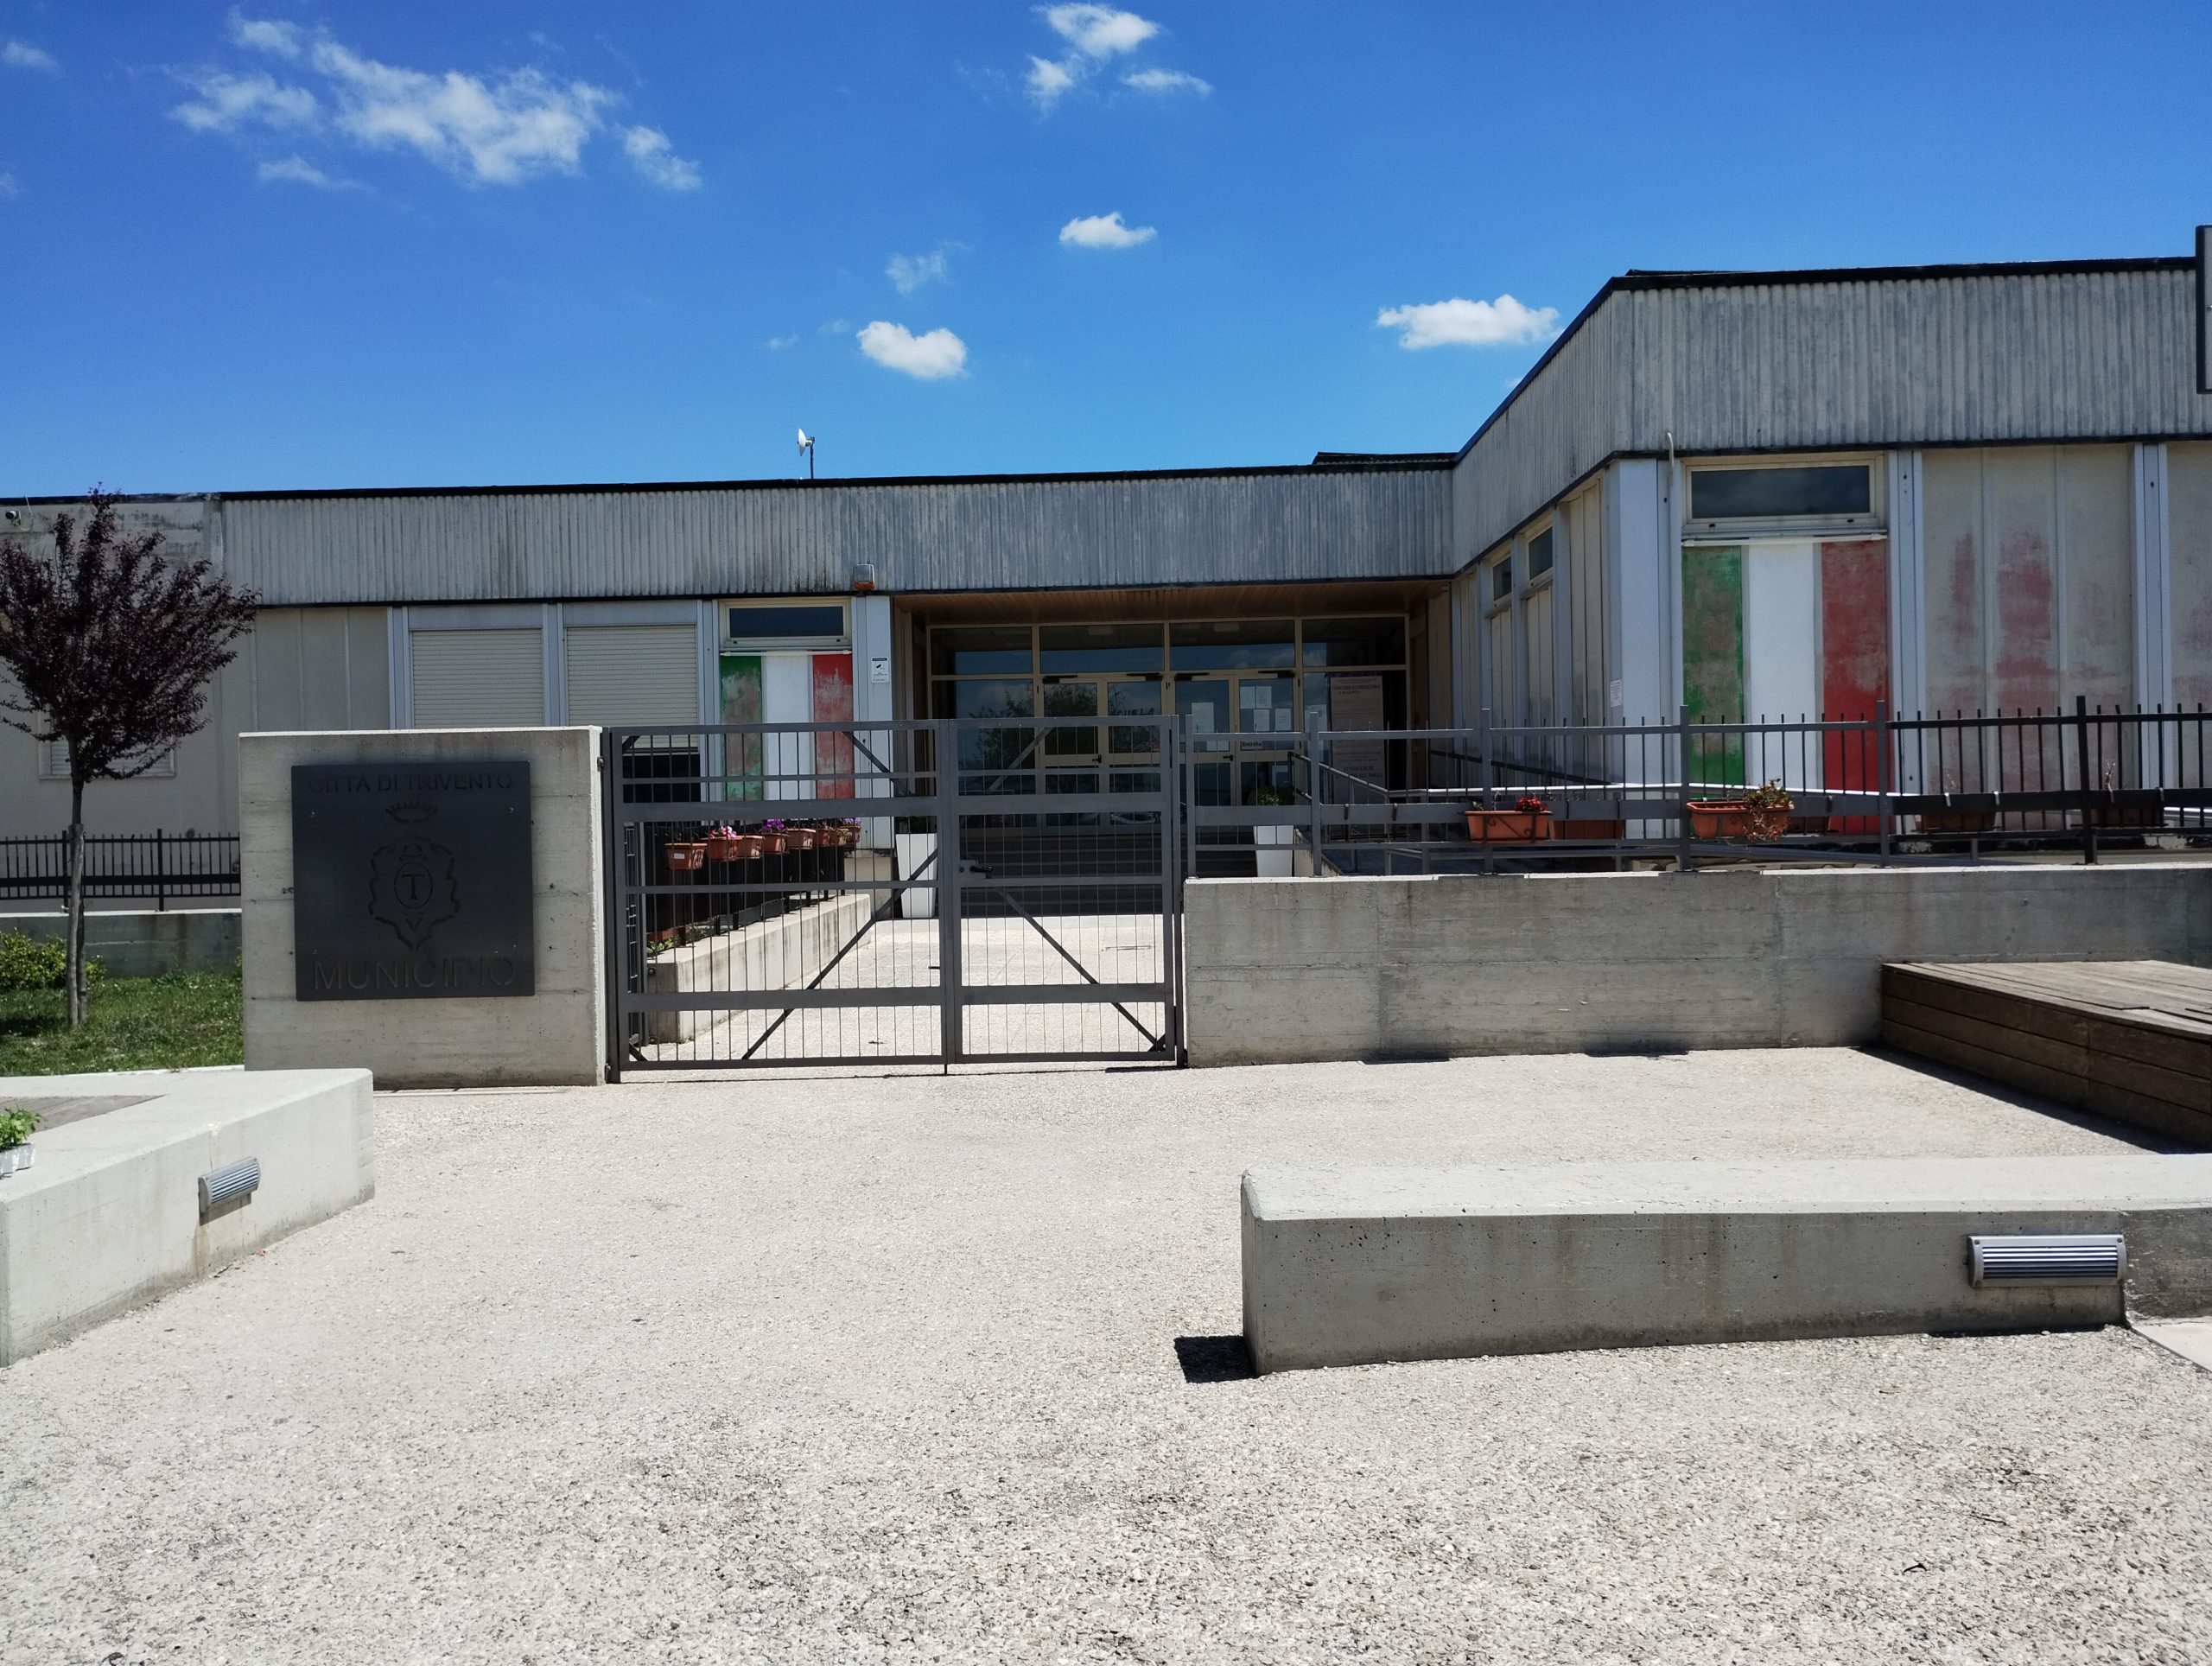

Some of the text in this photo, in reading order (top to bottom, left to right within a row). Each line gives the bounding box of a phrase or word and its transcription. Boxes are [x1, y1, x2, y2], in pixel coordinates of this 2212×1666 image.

[378, 773, 397, 792] DI
[407, 773, 512, 792] TRIVENTO
[401, 874, 425, 900] T
[314, 957, 516, 990] MUNICIPIO
